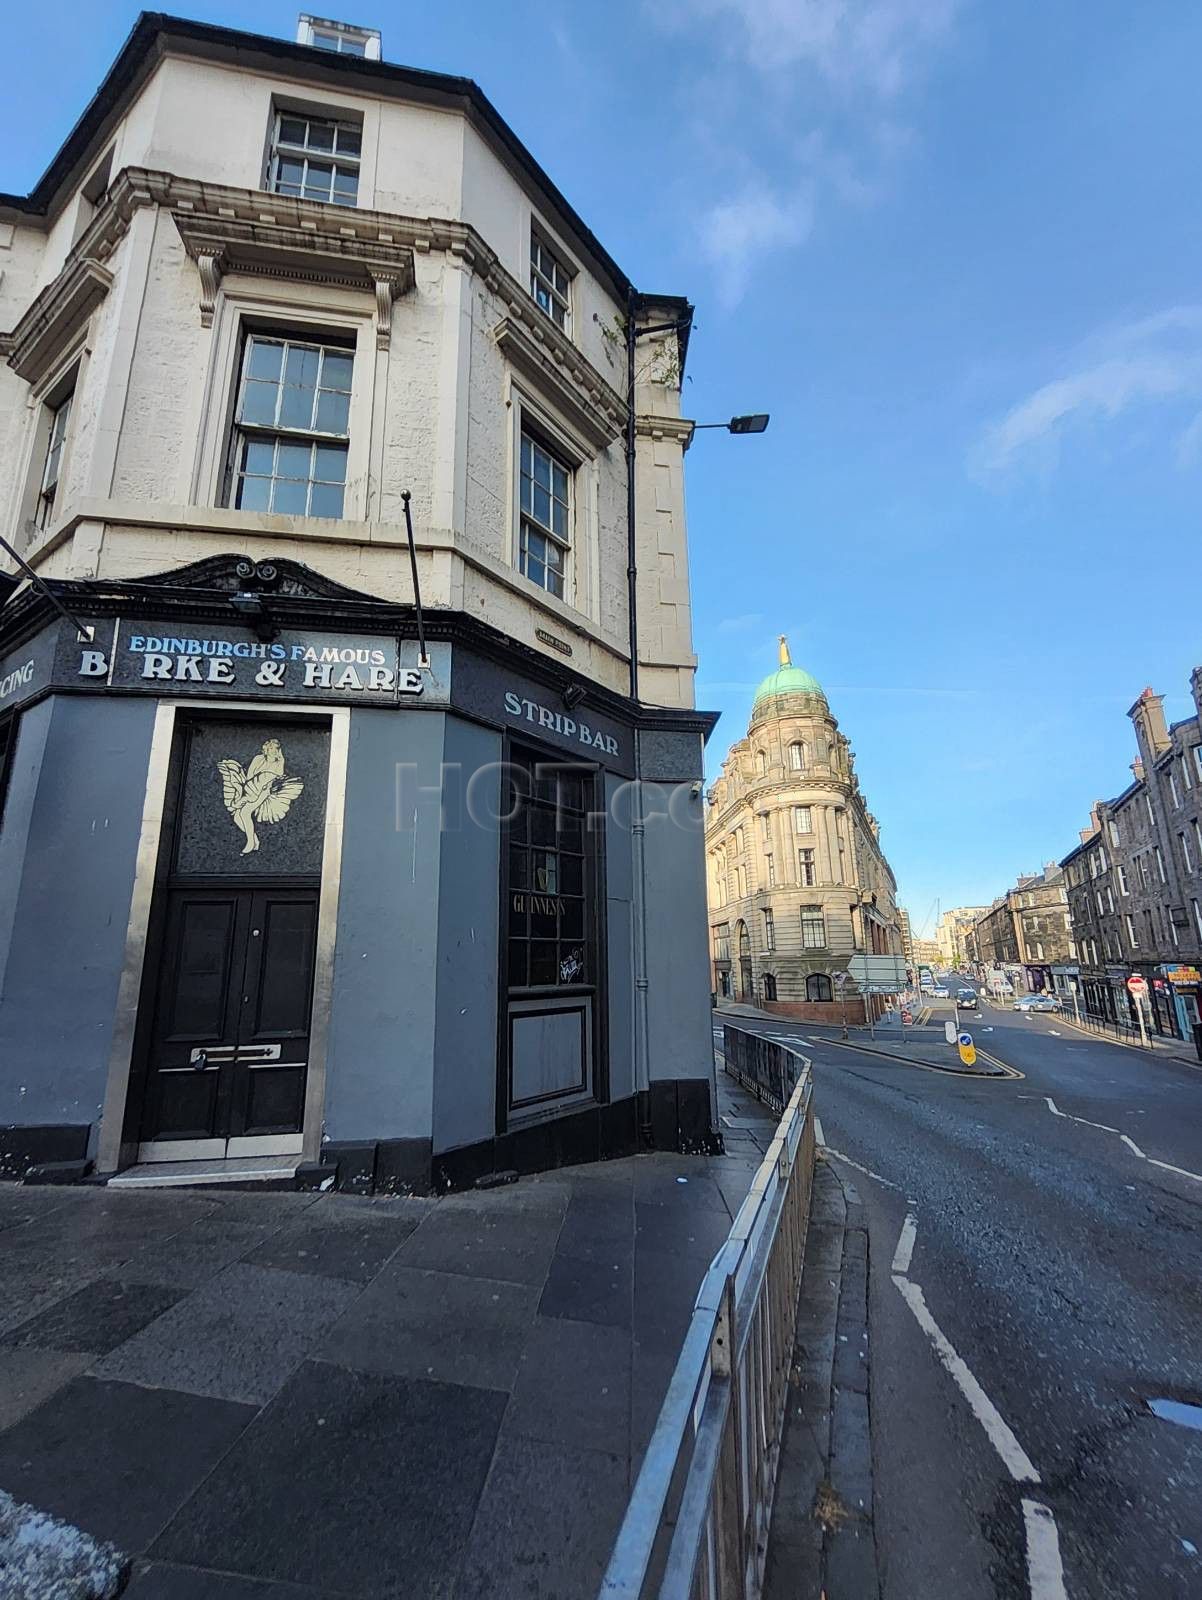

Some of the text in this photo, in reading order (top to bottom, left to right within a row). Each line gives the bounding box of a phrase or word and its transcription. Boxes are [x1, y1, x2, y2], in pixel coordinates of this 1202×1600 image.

[129, 636, 386, 665] EDINBURGH'S FAMOUS
[0, 660, 34, 698] CING
[255, 661, 285, 686] &
[303, 663, 424, 693] HARE
[504, 691, 619, 757] STRIP BAR
